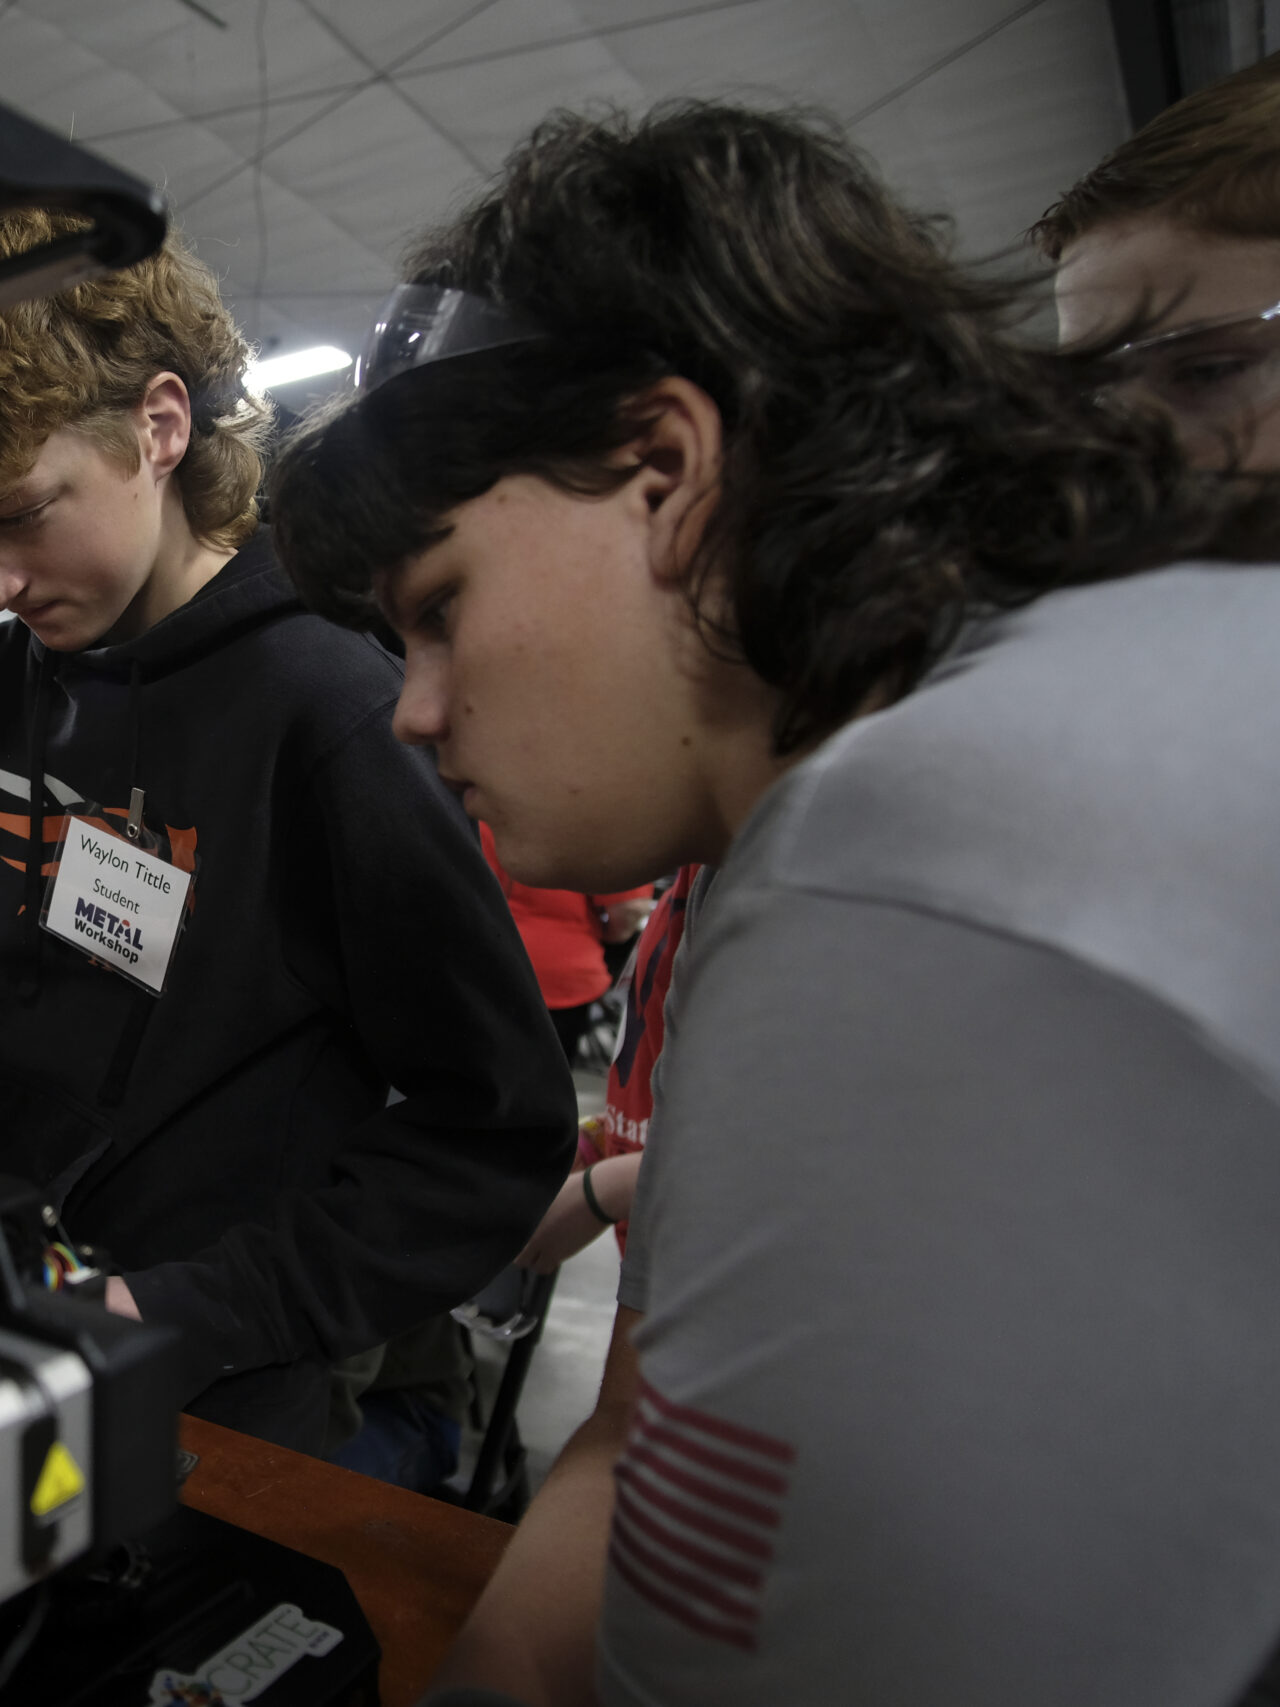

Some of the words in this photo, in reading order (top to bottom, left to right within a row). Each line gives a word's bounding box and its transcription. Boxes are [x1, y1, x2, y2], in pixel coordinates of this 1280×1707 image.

[81, 834, 130, 873] Waylon
[135, 861, 172, 894] Tittle
[75, 896, 144, 951] METAL
[93, 878, 141, 914] Student
[74, 917, 140, 965] Workshop
[207, 1608, 318, 1696] CRATE
